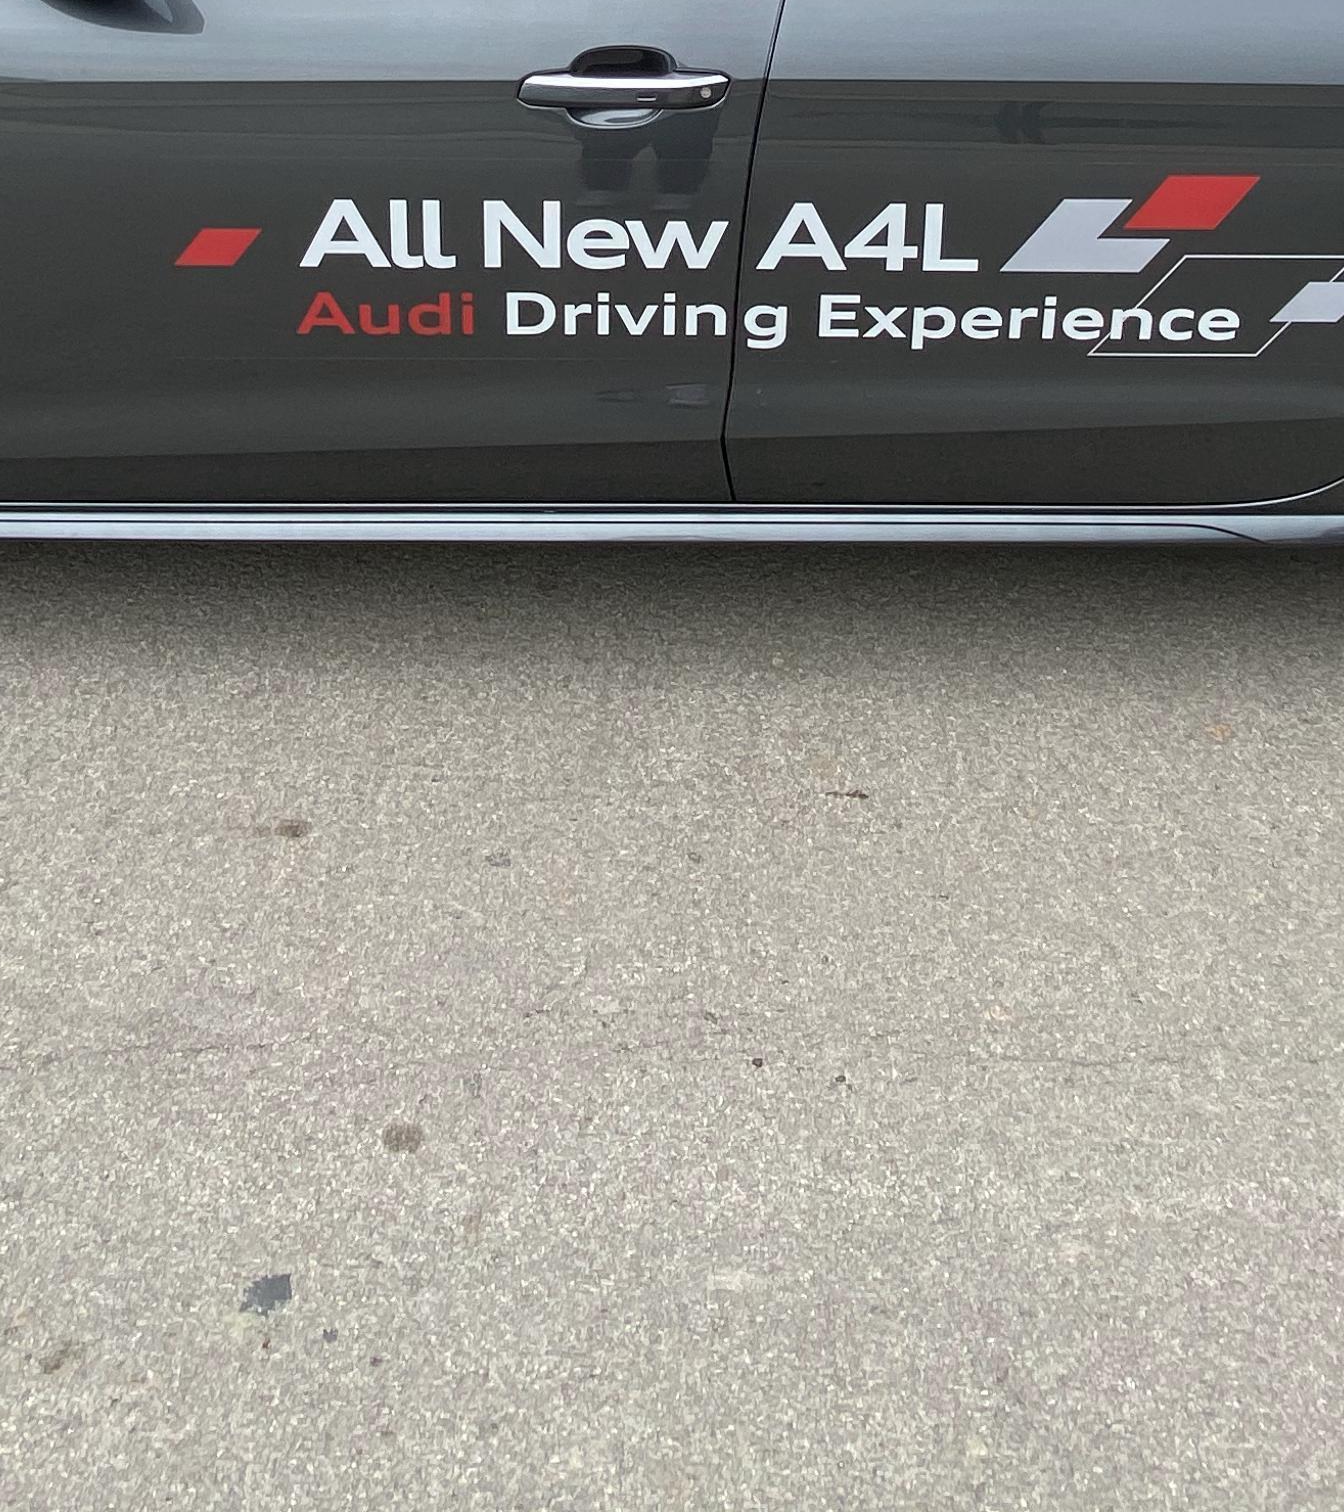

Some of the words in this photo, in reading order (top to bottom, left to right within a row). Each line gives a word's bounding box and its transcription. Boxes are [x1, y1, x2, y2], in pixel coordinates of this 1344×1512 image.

[299, 198, 456, 269] All
[483, 199, 730, 270] New
[755, 202, 979, 272] A4L
[296, 291, 475, 336] Audi
[506, 291, 788, 350] Driving
[818, 295, 1240, 350] Experience
